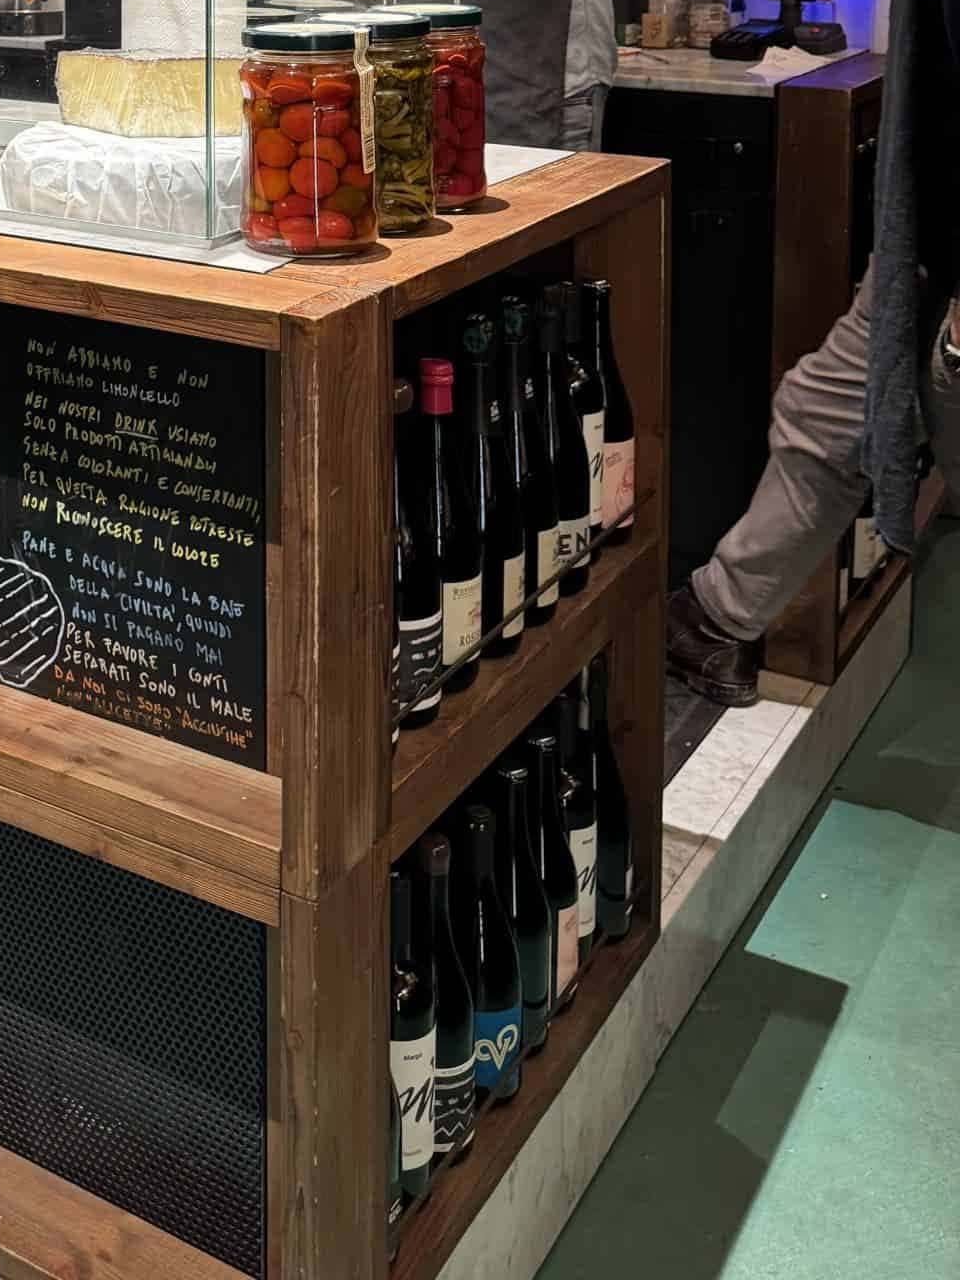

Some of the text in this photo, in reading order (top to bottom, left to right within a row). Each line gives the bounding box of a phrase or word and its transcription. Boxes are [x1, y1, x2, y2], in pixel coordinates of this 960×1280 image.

[26, 338, 210, 390] NON ABBIAMO E NON
[26, 362, 181, 407] OFFRIAMO LIMONCELLO
[23, 410, 217, 474] SOLO PRODOTTI ARTIGIANALI
[24, 390, 217, 449] NEI NOSTRI DRINK USIAMO
[23, 435, 70, 464] SENZA
[77, 453, 150, 485] COLORANTI
[157, 476, 169, 490] E
[21, 492, 221, 569] NON RICONOSCERE IL COLORE
[23, 462, 255, 548] PER QUESTA RAGIONE POTRESTE
[22, 530, 246, 619] PANE E ACQUA SONO LA BASE
[69, 574, 233, 640] DELLA QUINDI
[66, 622, 229, 693] PER FAVORE I CONTI
[71, 602, 224, 667] NON SI PAGANO MAI
[63, 644, 131, 682] SEPARATI
[139, 674, 177, 699] SONO
[186, 692, 201, 711] IL
[210, 696, 253, 724] MALE
